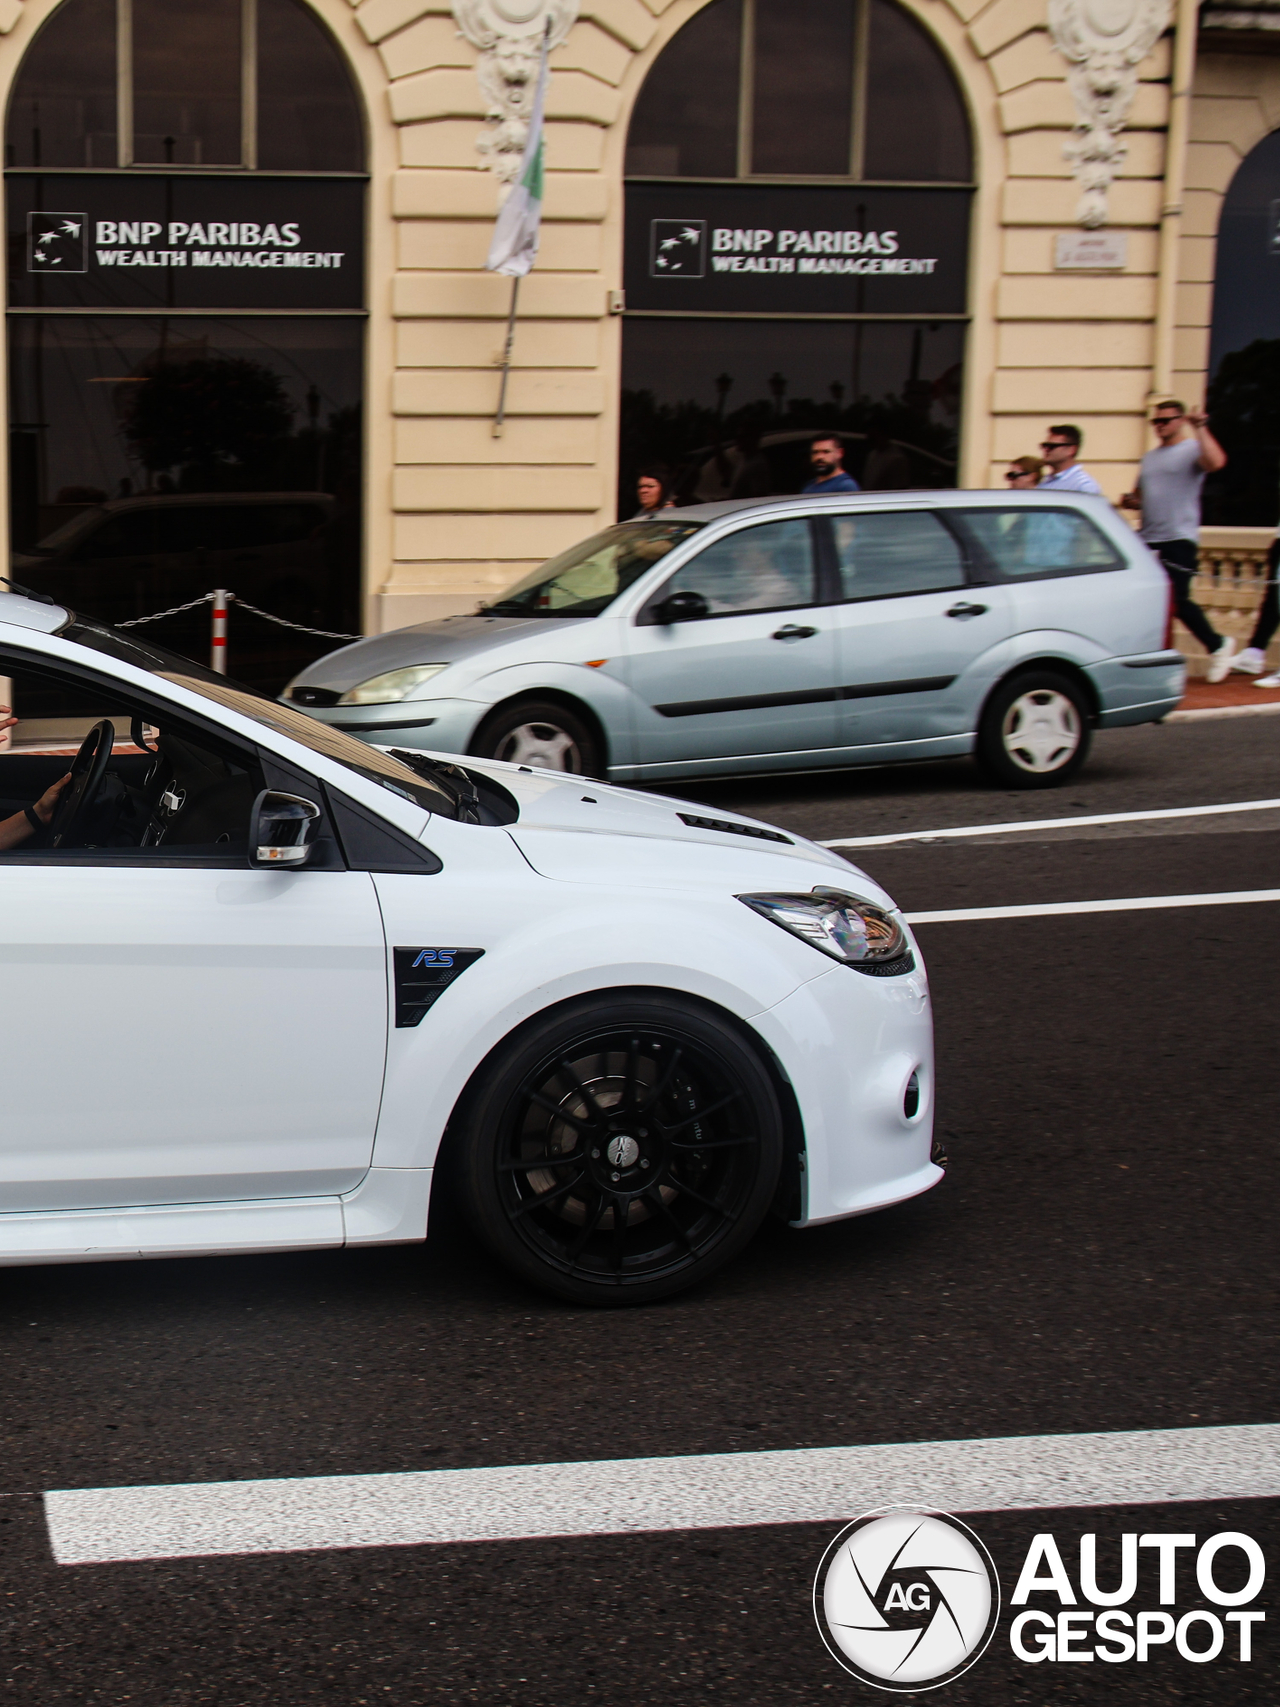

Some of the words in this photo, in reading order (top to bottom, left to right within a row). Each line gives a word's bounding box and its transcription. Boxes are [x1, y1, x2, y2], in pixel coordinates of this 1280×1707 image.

[95, 221, 162, 245] BNP
[168, 222, 301, 247] PARIBAS
[712, 228, 774, 252] BNP
[777, 230, 899, 255] PARIBAS
[95, 250, 187, 267] WEALTH
[191, 251, 345, 268] MANAGEMENT
[712, 256, 795, 273] WEALTH
[798, 257, 937, 275] MANAGEMENT
[411, 949, 458, 968] RS
